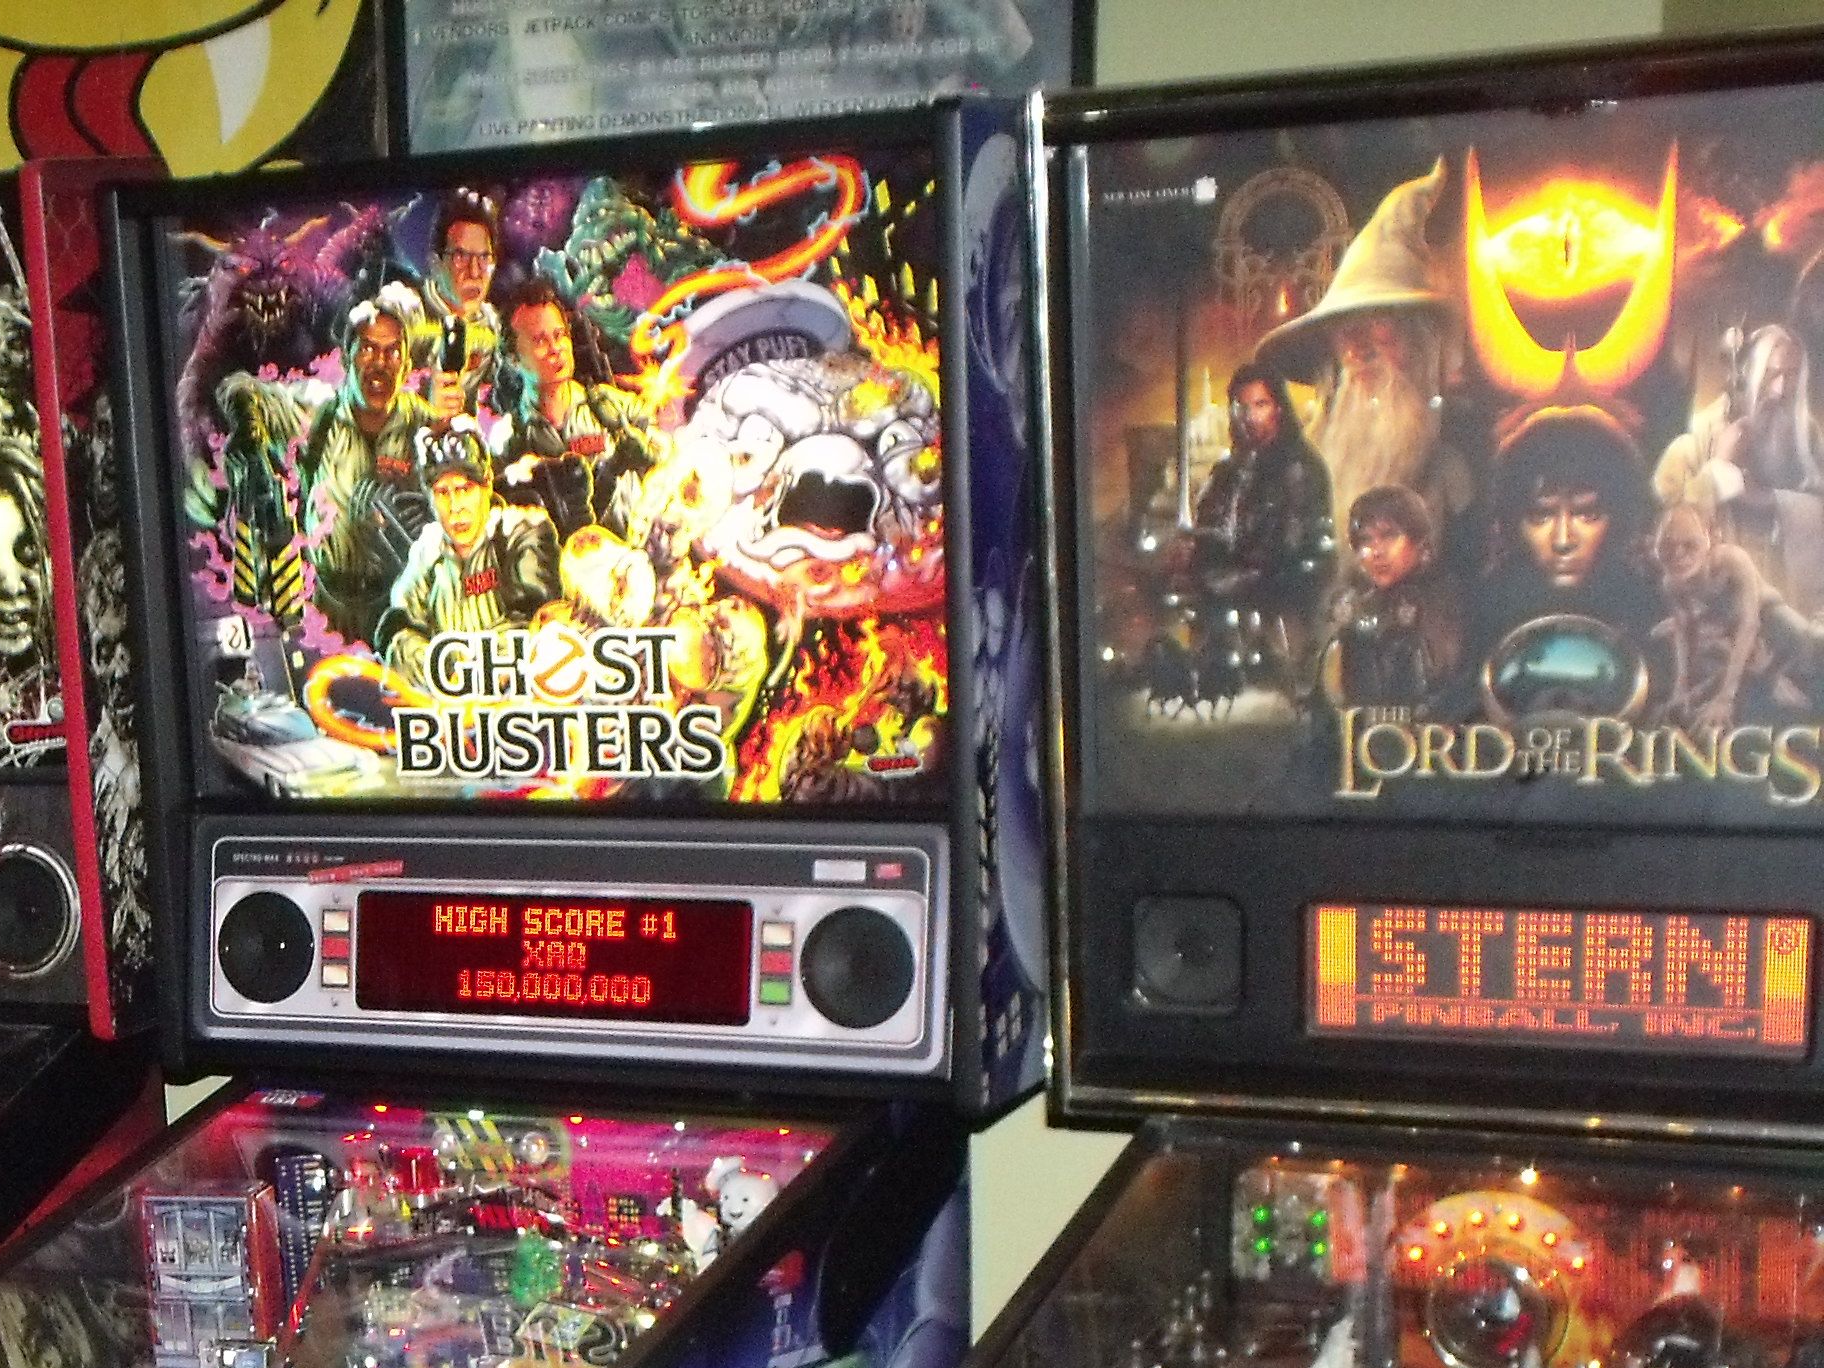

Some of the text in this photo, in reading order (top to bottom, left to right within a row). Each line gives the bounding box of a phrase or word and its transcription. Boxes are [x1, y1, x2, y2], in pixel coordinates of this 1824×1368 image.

[524, 15, 596, 34] JETPACK
[756, 334, 809, 364] PUFT
[426, 631, 678, 700] GHOST
[396, 708, 724, 776] BUSTERS
[1334, 704, 1824, 808] LORD OF THE RINGS
[434, 905, 677, 939] HIGH SCORE #1
[1371, 907, 1750, 1009] STERN
[457, 969, 652, 1006] 150,000,000
